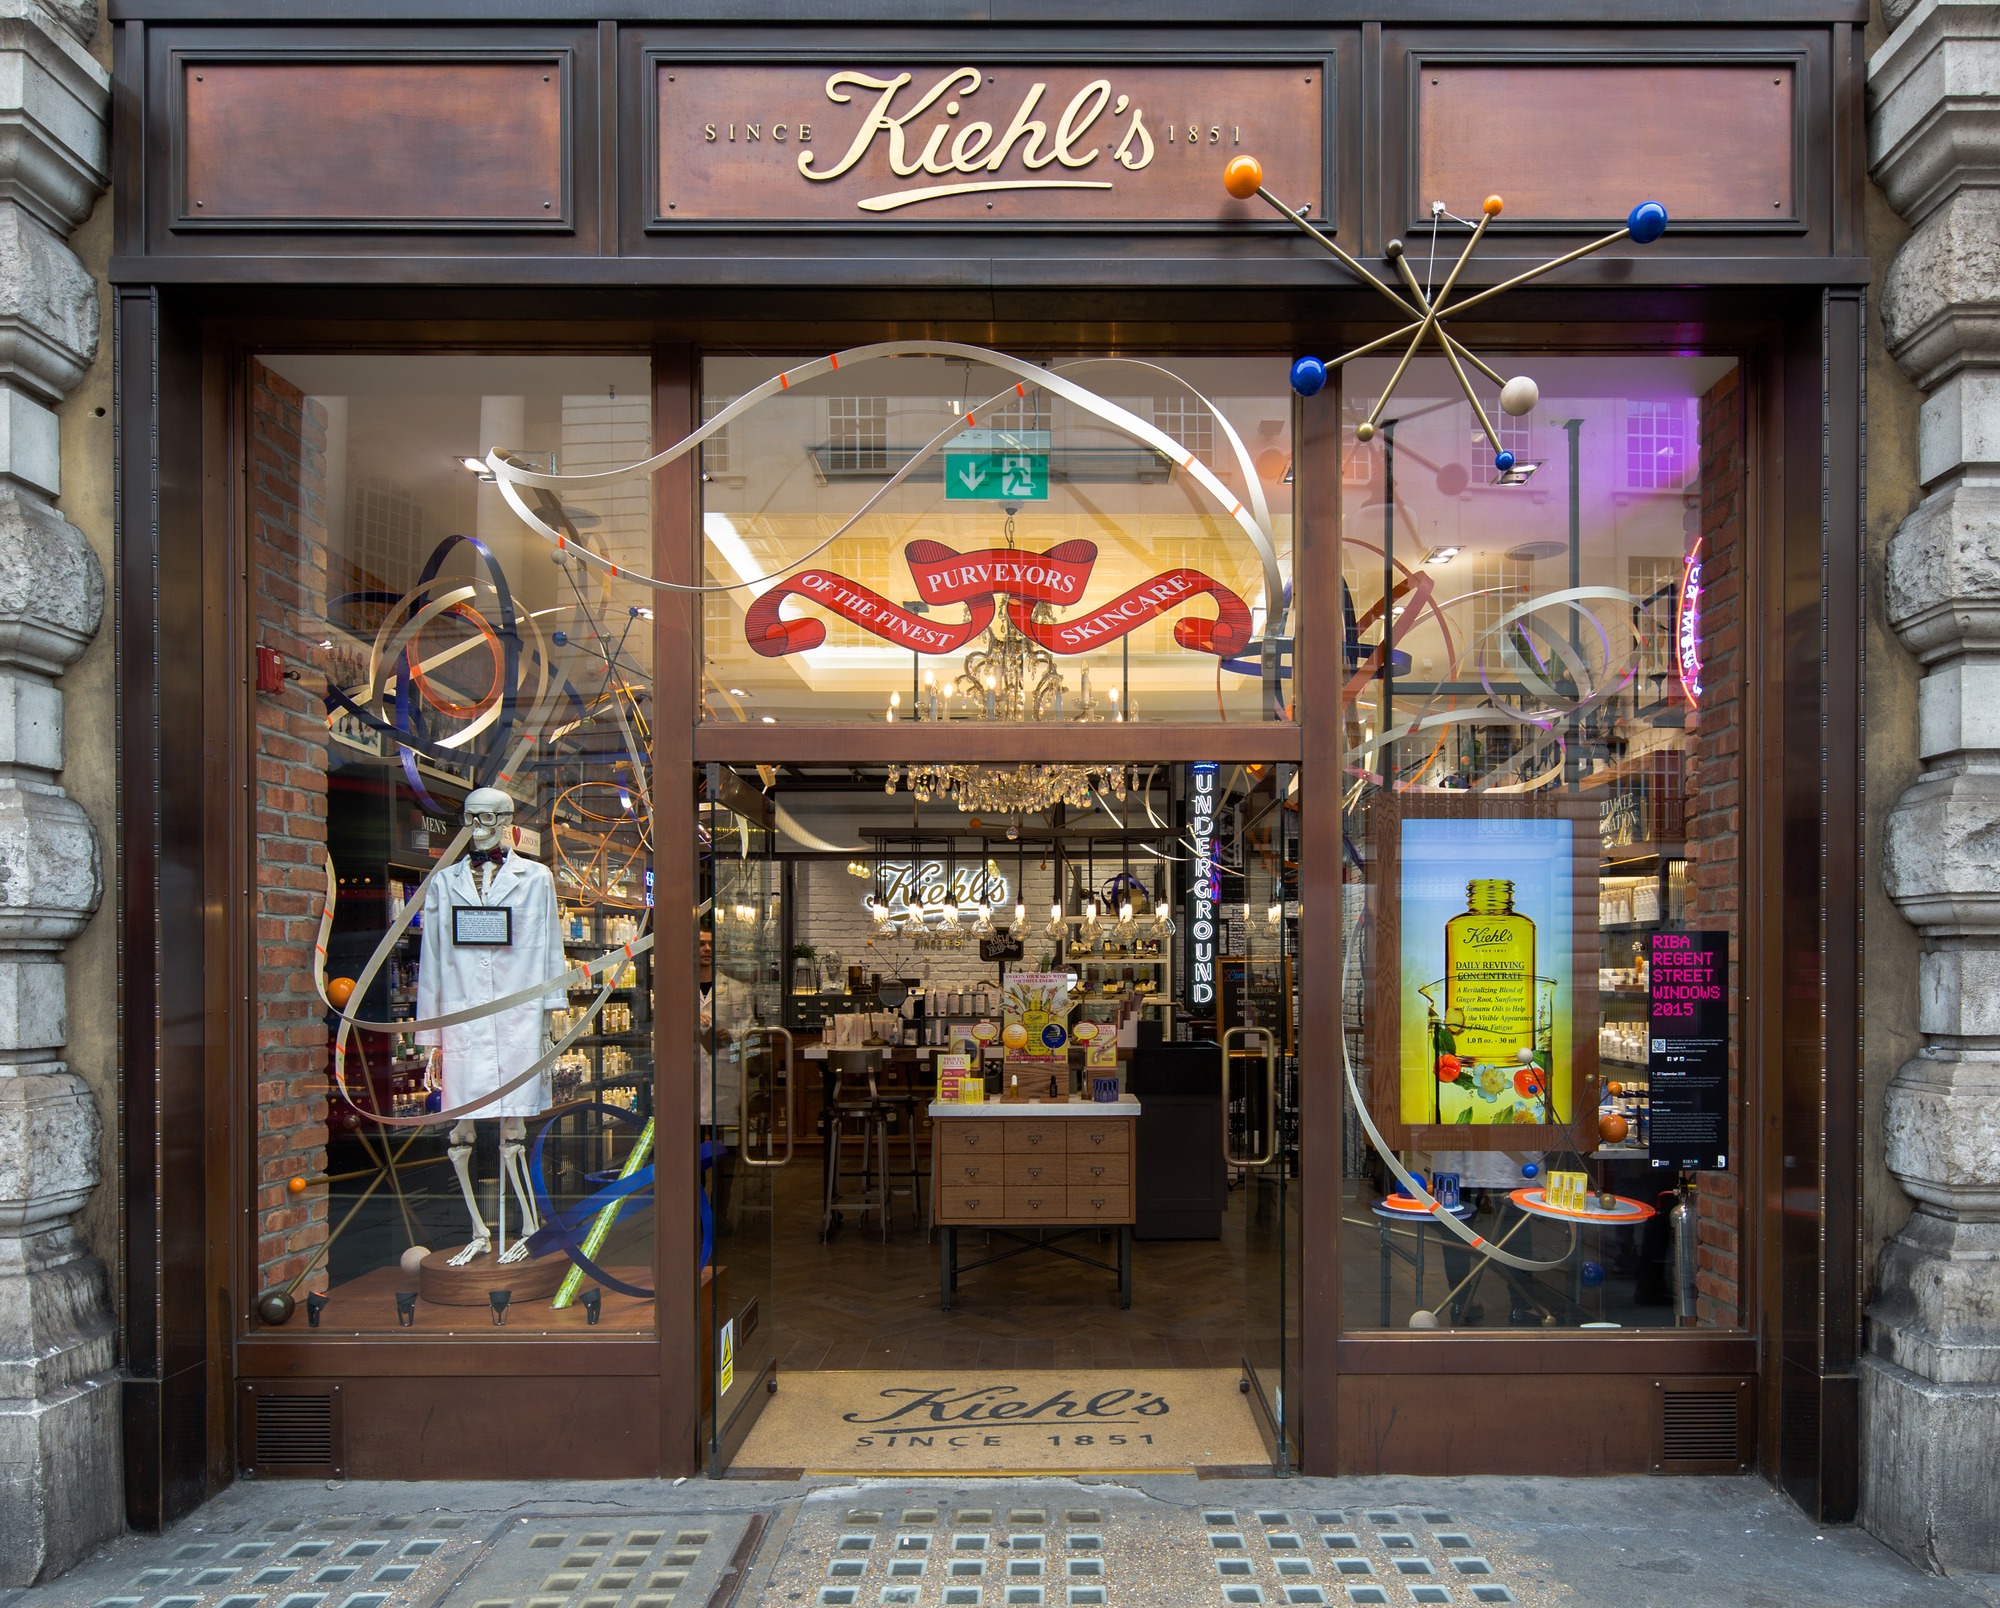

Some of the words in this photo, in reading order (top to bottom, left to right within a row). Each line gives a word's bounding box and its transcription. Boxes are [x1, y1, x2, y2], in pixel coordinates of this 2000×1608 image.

[705, 123, 812, 142] SINCE
[798, 67, 1155, 180] Kiehl's
[1168, 125, 1242, 144] 1851
[926, 563, 1077, 594] PURVEYORS
[802, 575, 836, 592] OF
[833, 588, 877, 617] THE
[875, 610, 954, 647] FINEST
[1060, 574, 1193, 646] SKINCARE
[421, 815, 447, 835] MEN'S
[866, 863, 1006, 908] Kiehl's
[1194, 774, 1214, 1003] UNDERGROUND
[1463, 927, 1513, 944] Kiehl's
[1653, 935, 1690, 949] RIBA
[1456, 961, 1481, 970] DAILY
[1482, 961, 1525, 970] REVIVING
[1653, 952, 1714, 966] REGENT
[1457, 971, 1523, 981] CONCENTRATE
[1653, 969, 1714, 982] STREET
[1463, 986, 1497, 994] Revitalizing
[1517, 986, 1524, 994] of
[1653, 985, 1720, 999] WINDOWS
[1456, 996, 1475, 1004] Ginger
[1495, 996, 1524, 1004] Sunflower
[1653, 1002, 1693, 1016] 2015
[1500, 1015, 1533, 1023] Appearance
[1490, 1024, 1513, 1032] Fatigue
[843, 1386, 1170, 1423] Kiehl's
[856, 1436, 1001, 1447] SINCE
[1047, 1434, 1155, 1446] 1851
